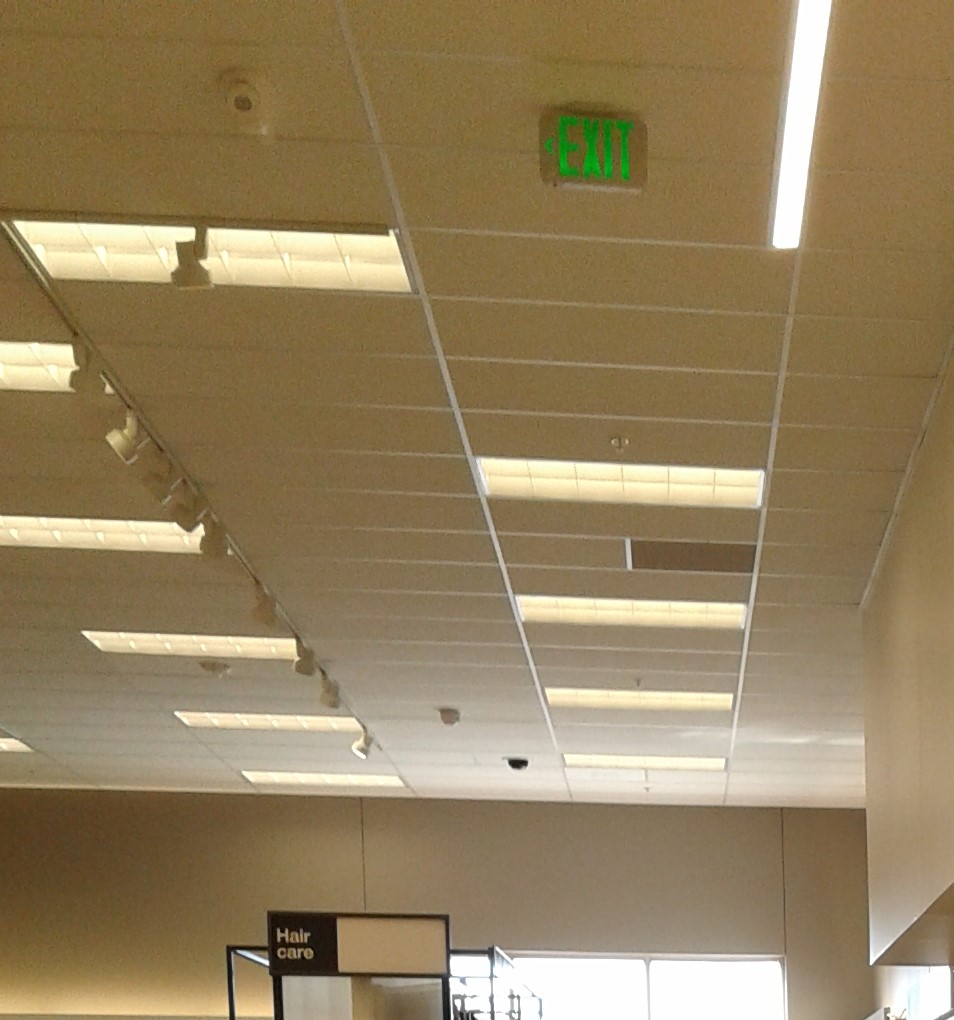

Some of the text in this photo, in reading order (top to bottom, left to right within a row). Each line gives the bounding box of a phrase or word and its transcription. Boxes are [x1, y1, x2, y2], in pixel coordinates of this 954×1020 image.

[558, 115, 635, 182] EXIT
[276, 927, 311, 944] Hair
[276, 947, 315, 960] care
